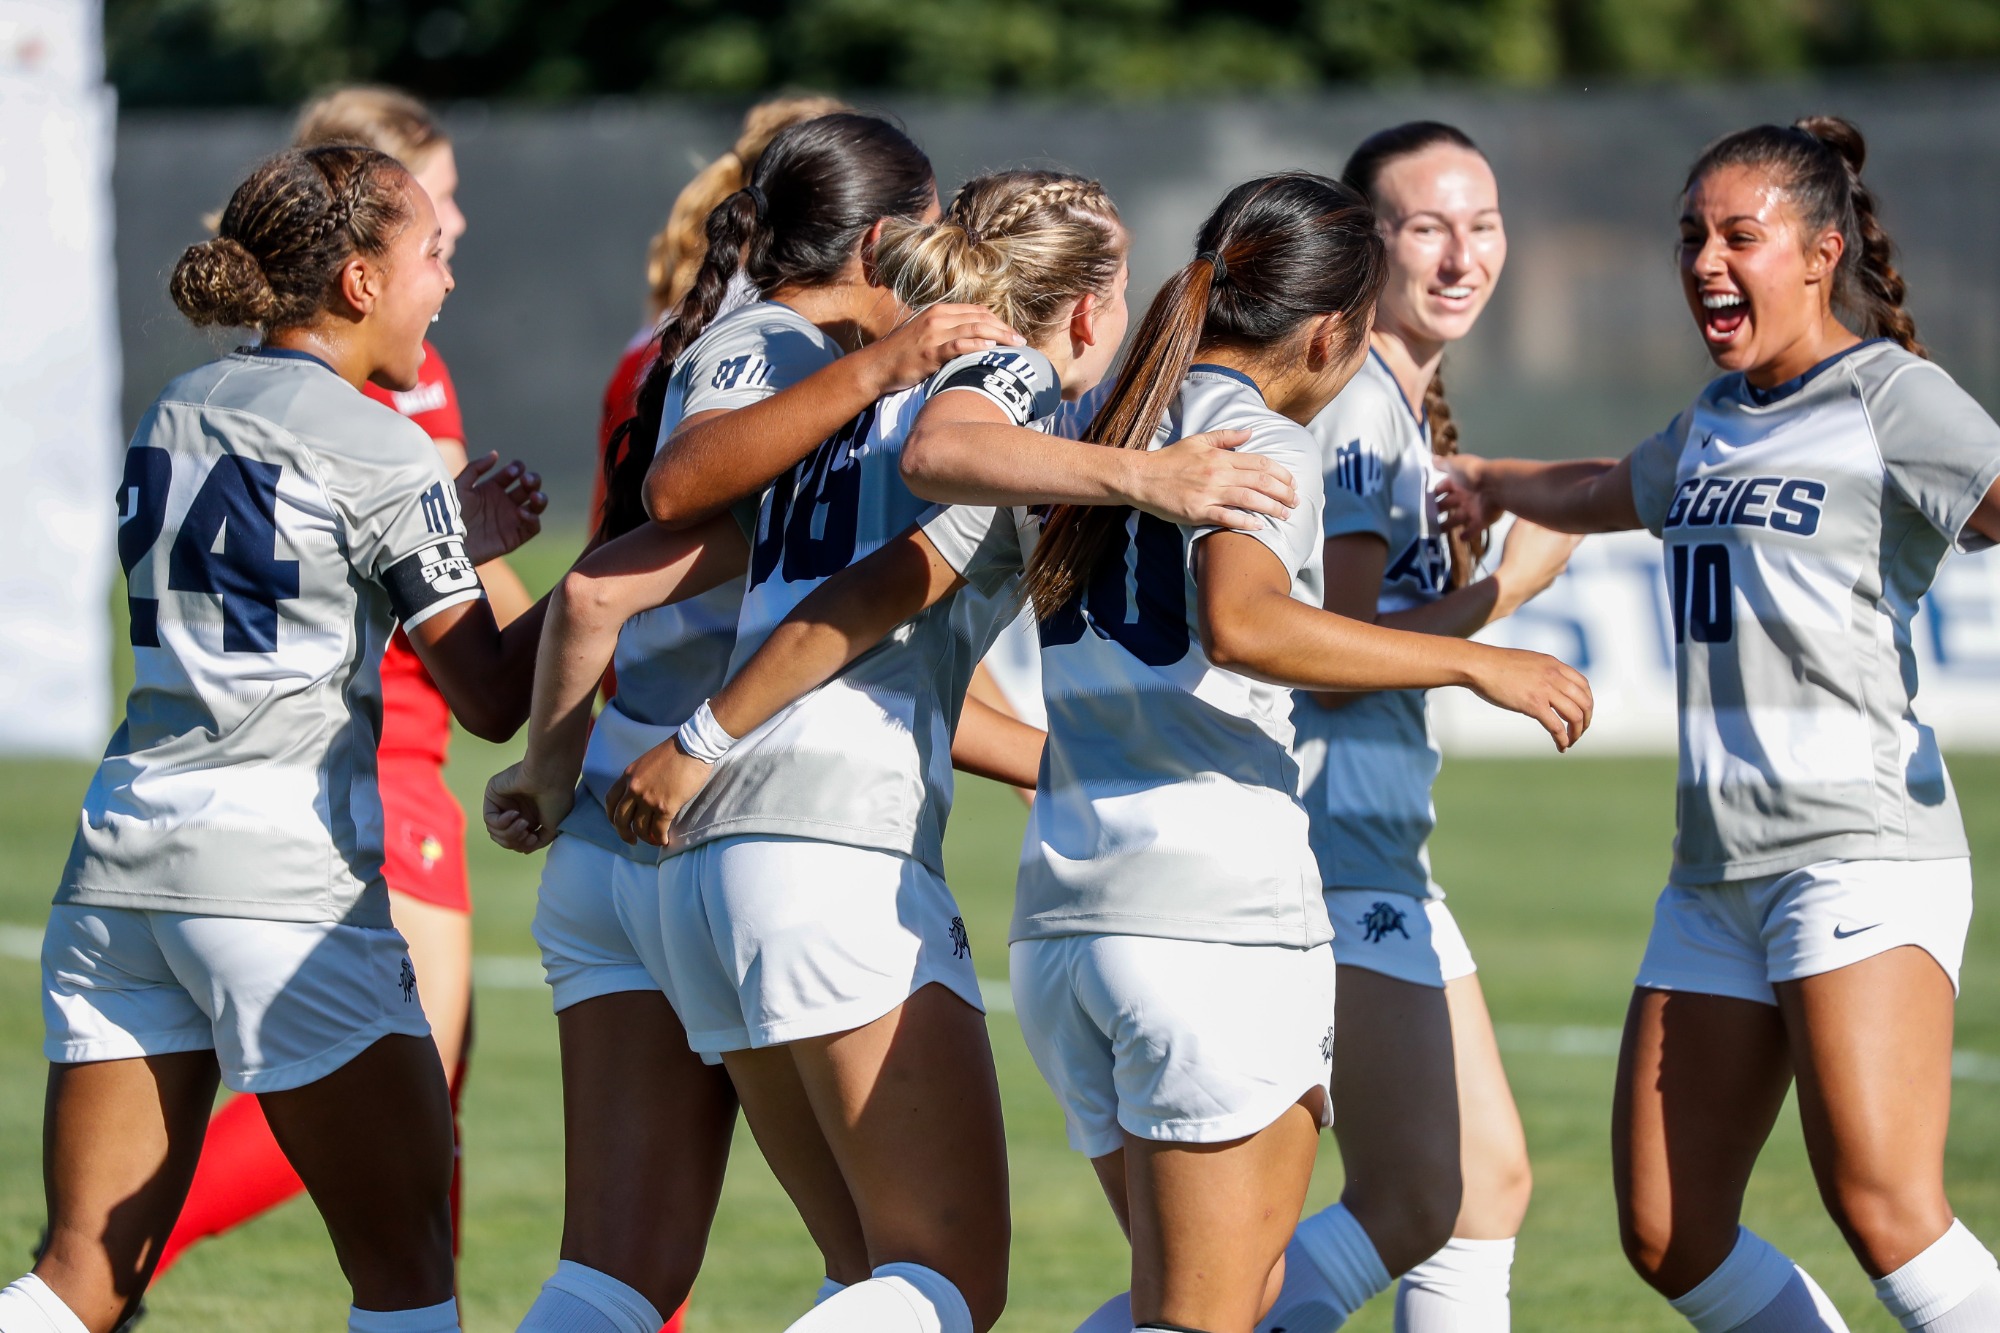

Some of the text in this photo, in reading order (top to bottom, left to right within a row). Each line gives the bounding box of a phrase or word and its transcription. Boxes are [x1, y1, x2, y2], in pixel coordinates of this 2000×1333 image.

[1664, 476, 1828, 538] GGIES
[116, 446, 300, 652] 24
[420, 556, 476, 584] STATE
[1673, 543, 1732, 643] 10
